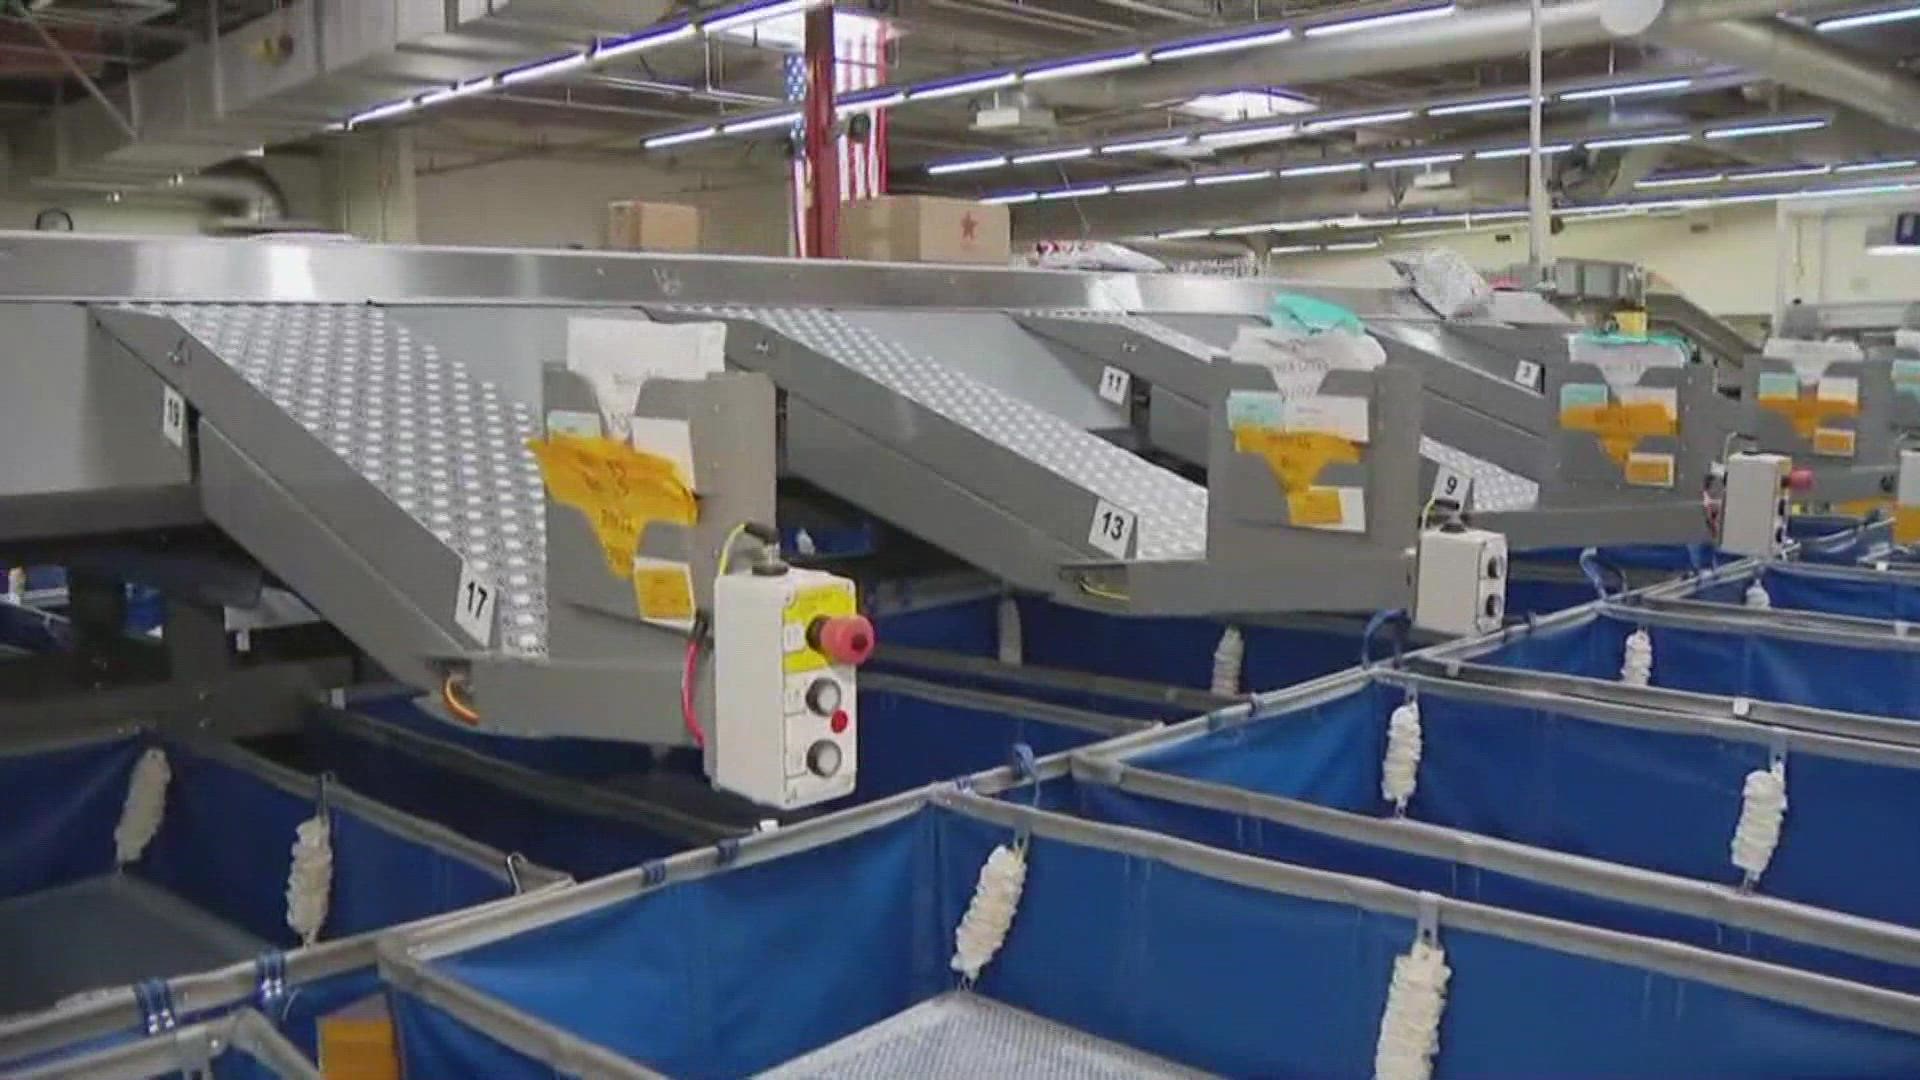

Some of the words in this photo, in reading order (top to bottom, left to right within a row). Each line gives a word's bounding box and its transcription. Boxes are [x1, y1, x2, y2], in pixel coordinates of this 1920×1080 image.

[1446, 476, 1457, 495] 9
[1103, 511, 1124, 540] 13
[468, 581, 487, 619] 17
